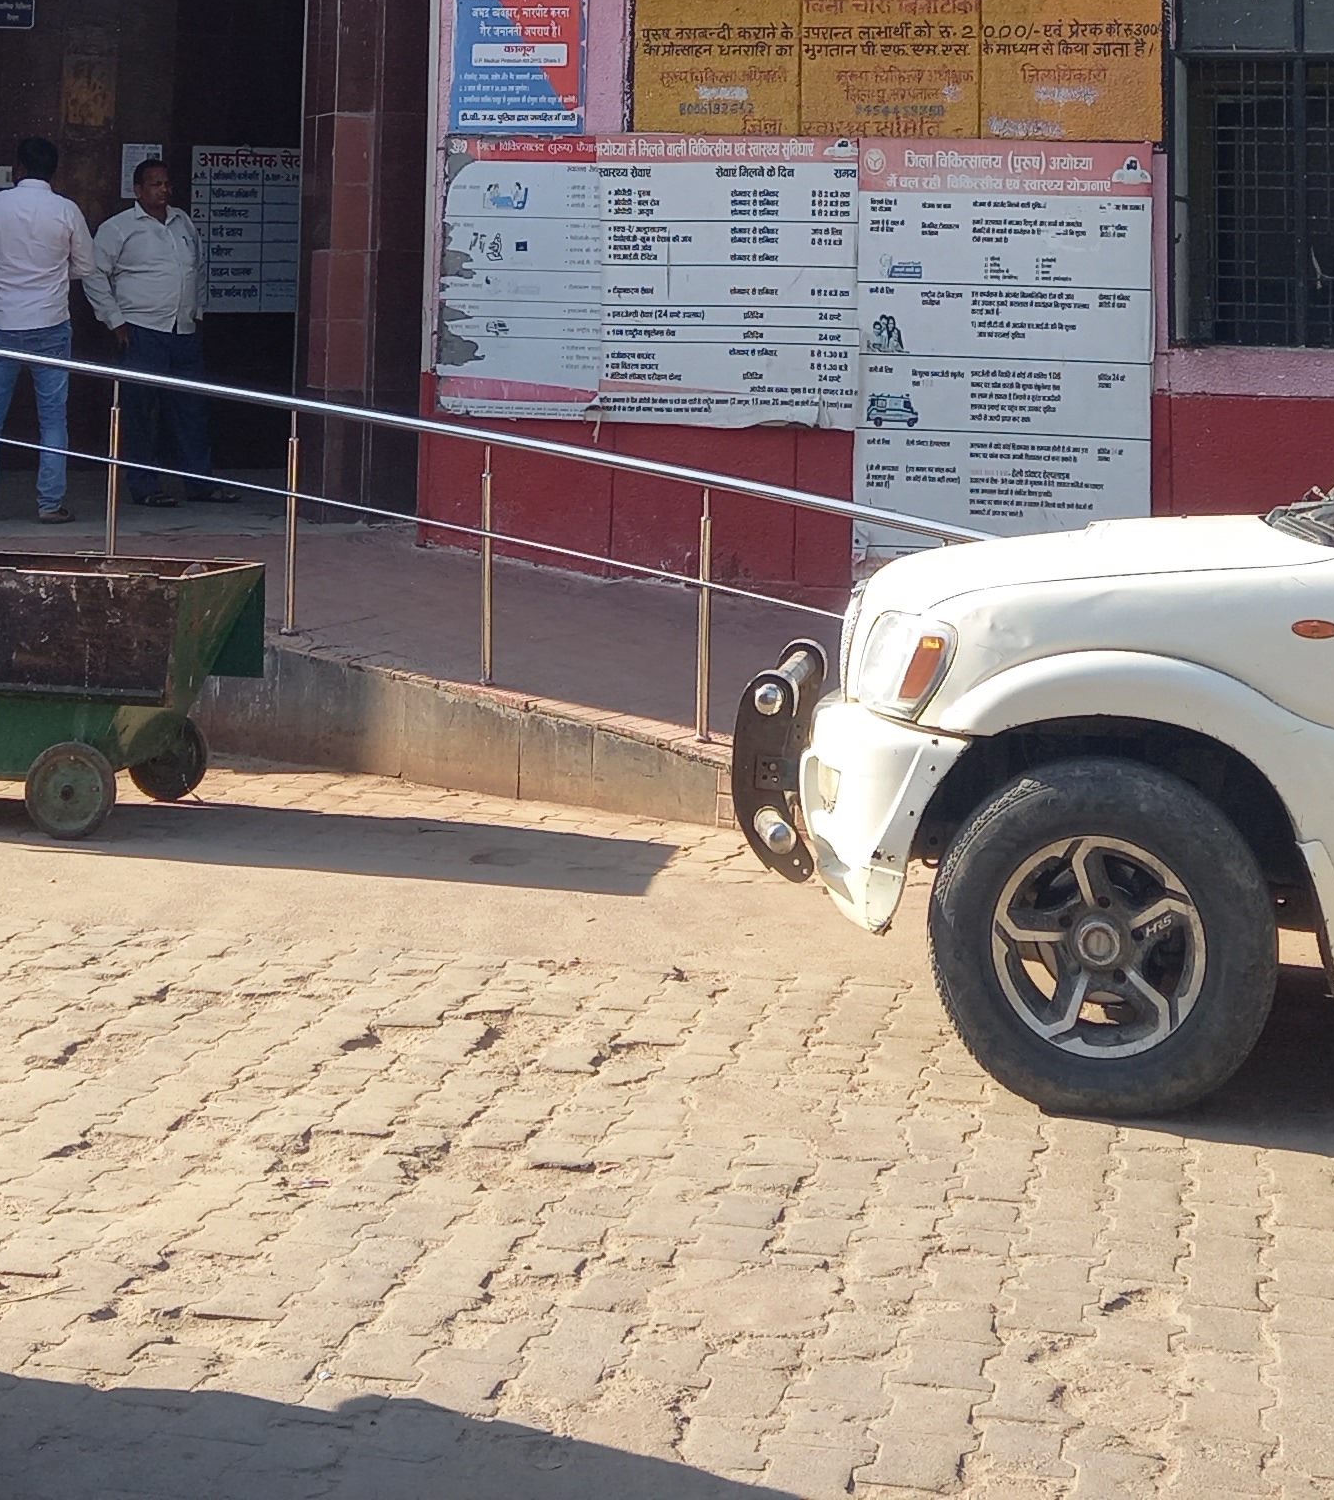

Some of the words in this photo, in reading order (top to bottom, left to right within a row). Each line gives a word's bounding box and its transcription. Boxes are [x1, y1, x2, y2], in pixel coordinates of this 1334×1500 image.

[550, 7, 569, 18] करना
[480, 21, 491, 37] गैर
[524, 25, 549, 37] अपराध
[675, 23, 730, 41] नसबन्दी
[737, 22, 777, 41] कराने
[780, 22, 795, 41] के
[803, 25, 854, 41] उपरान्त
[914, 20, 935, 40] को
[1042, 19, 1063, 39] एवं
[1068, 18, 1103, 39] प्रेरक
[1105, 19, 1120, 37] को
[661, 42, 713, 58] प्रोत्साहन
[717, 40, 772, 57] धनराशि
[775, 43, 795, 57] का
[803, 43, 858, 60] भुगतान
[982, 39, 994, 57] के
[996, 41, 1040, 57] माध्यम
[1041, 41, 1056, 56] से
[1058, 40, 1089, 57] किया
[1092, 41, 1131, 58] जाता
[1020, 62, 1108, 84] जिलाधिकारी
[742, 114, 784, 137] जिला
[198, 148, 277, 169] आकस्मिक
[628, 139, 637, 157] में
[638, 139, 665, 157] मिलने
[667, 140, 687, 157] वाली
[734, 138, 746, 157] एवं
[748, 142, 780, 158] स्वास्थ्य
[781, 138, 815, 161] सुविधाएं
[905, 150, 933, 168] जिला
[935, 151, 1002, 170] चिकित्सालय
[1049, 154, 1093, 171] अयोध्या
[598, 166, 628, 178] स्वास्थ्य
[738, 165, 765, 178] मिलने
[766, 165, 776, 178] के
[777, 165, 795, 178] दिन
[833, 168, 857, 179] समय
[887, 173, 898, 187] में
[921, 174, 941, 188] रही
[1006, 177, 1020, 191] एवं
[1023, 179, 1064, 191] स्वास्थ्य
